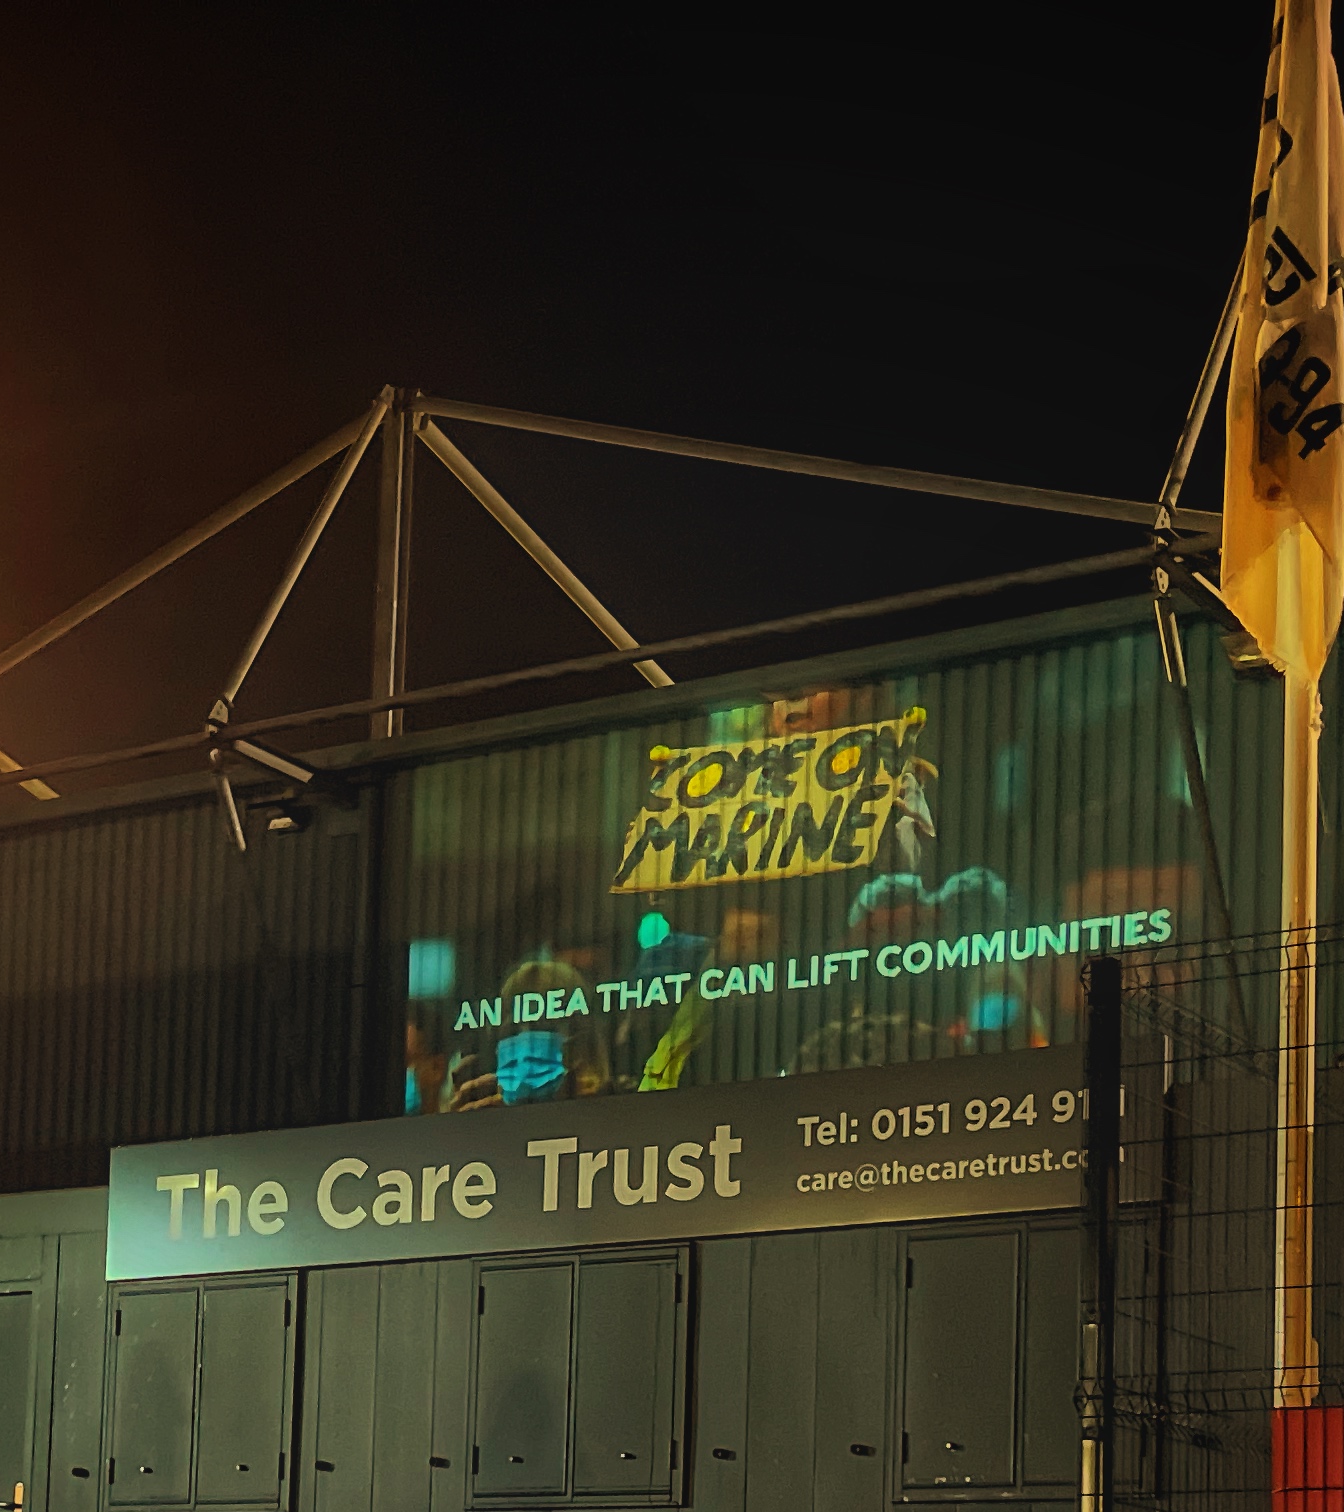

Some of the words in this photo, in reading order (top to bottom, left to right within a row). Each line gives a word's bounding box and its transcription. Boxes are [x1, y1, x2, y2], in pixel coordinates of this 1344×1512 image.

[650, 738, 815, 812] COME
[816, 723, 925, 791] ON
[614, 784, 890, 885] MARINE
[454, 1000, 502, 1031] AN
[513, 988, 588, 1024] IDEA
[596, 972, 690, 1012] THAT
[700, 962, 774, 1000] CAN
[787, 950, 869, 989] LIFT
[875, 908, 1173, 978] COMMUNITIES
[797, 1112, 858, 1147] Tel:
[871, 1102, 950, 1141] 0151
[964, 1093, 1037, 1132] 924
[157, 1169, 288, 1240] The
[317, 1157, 496, 1229] Care
[527, 1125, 742, 1212] Trust
